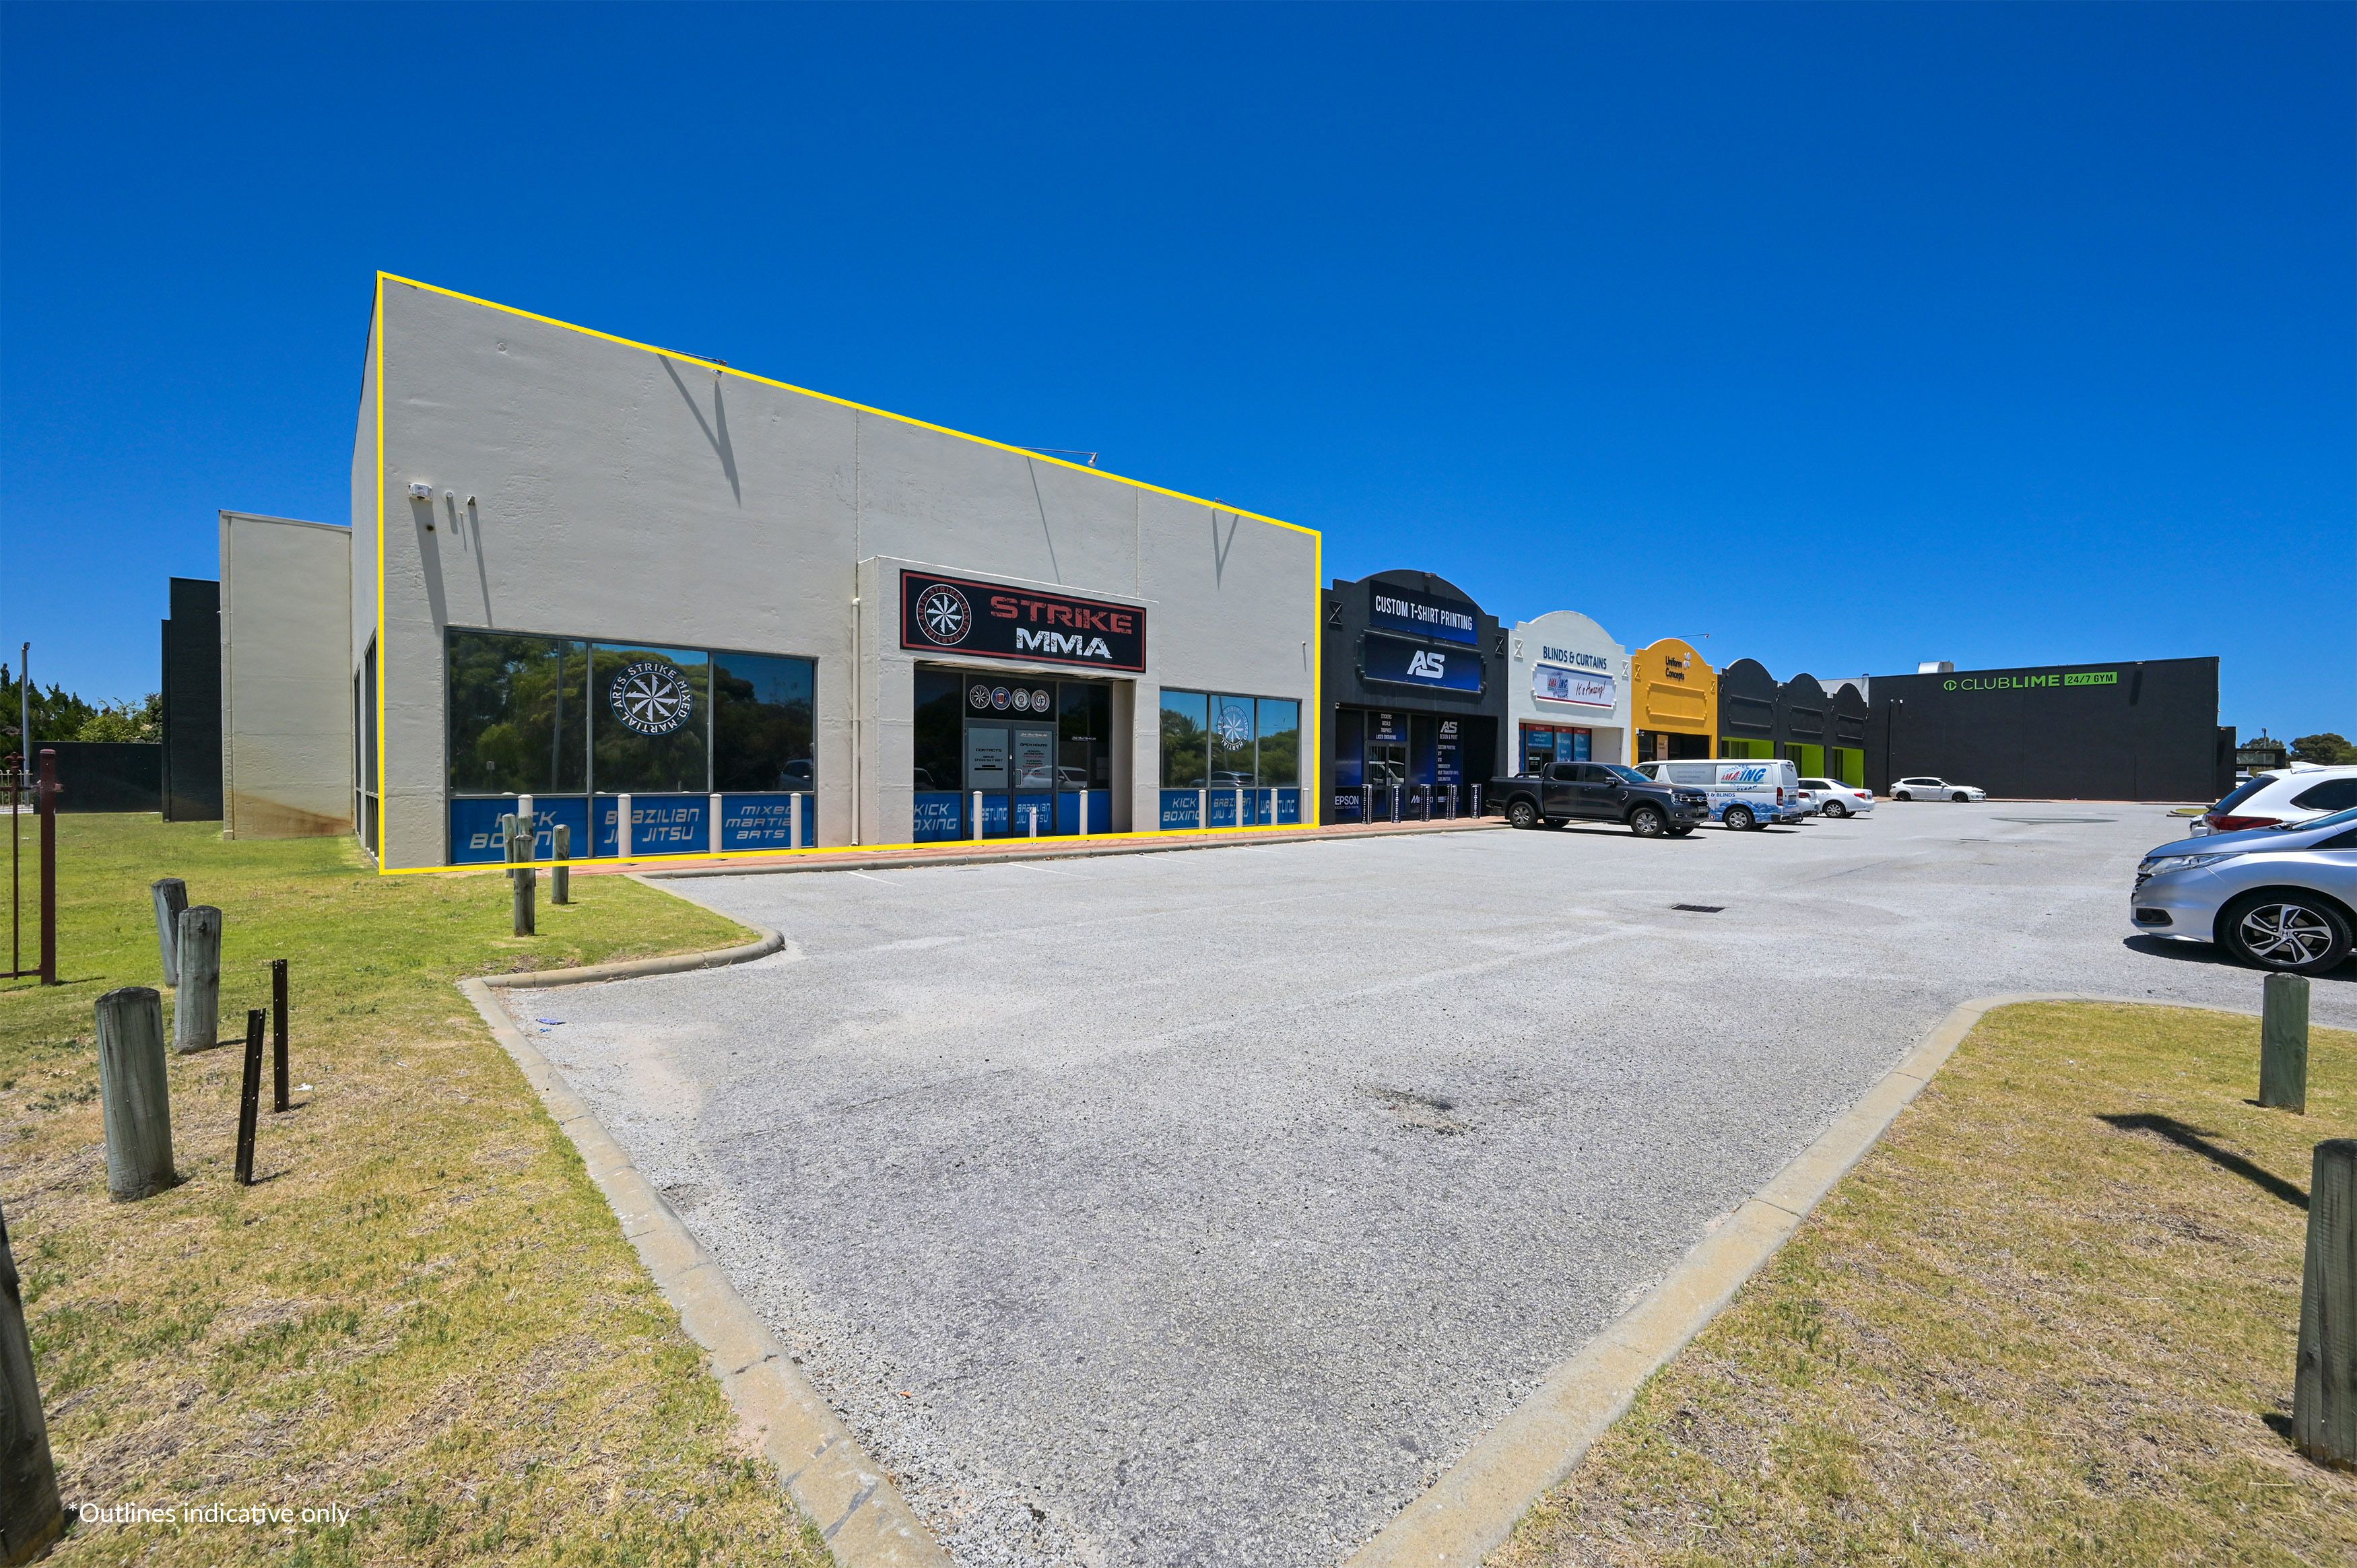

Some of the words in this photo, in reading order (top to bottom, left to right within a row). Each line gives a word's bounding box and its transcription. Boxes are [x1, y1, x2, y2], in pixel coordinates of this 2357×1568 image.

[929, 586, 960, 599] STRIKE
[919, 595, 928, 620] ARTS
[990, 595, 1133, 635] STRIKE
[1375, 595, 1408, 617] CUSTOM
[1410, 603, 1439, 624] T-SHIRT
[1440, 610, 1473, 631] PRINTING
[960, 603, 970, 633] MIXED
[924, 624, 960, 644] MARTIAL
[1016, 627, 1113, 659] MMA
[1406, 650, 1446, 679] AS
[1543, 646, 1568, 662] BLINDS
[1569, 651, 1574, 664] &
[1576, 653, 1607, 670] CURTAINS
[1665, 656, 1683, 668] Uniform
[628, 662, 677, 679] STRIKE
[1665, 667, 1685, 681] Concepts
[2067, 675, 2091, 684] 24/7
[2094, 674, 2114, 683] GYM
[612, 676, 626, 708] ARTS
[1585, 679, 1606, 700] Amazing!
[677, 680, 691, 718] MIXED
[622, 712, 678, 733] MARTIAL
[1440, 721, 1458, 733] AS
[1221, 737, 1244, 751] MARTIAL
[1172, 797, 1197, 808] KICK
[1214, 796, 1251, 807] BRAZIAN
[1260, 799, 1295, 814] WRTLING
[1335, 795, 1359, 805] EPSON
[605, 808, 700, 825] BAZILIAN
[914, 803, 950, 816] KICK
[1213, 809, 1225, 819] JIU
[725, 818, 791, 827] MARTIA
[913, 818, 957, 832] OXING
[1016, 814, 1027, 824] JIU
[604, 829, 632, 844] JI
[736, 829, 786, 840] ARTS
